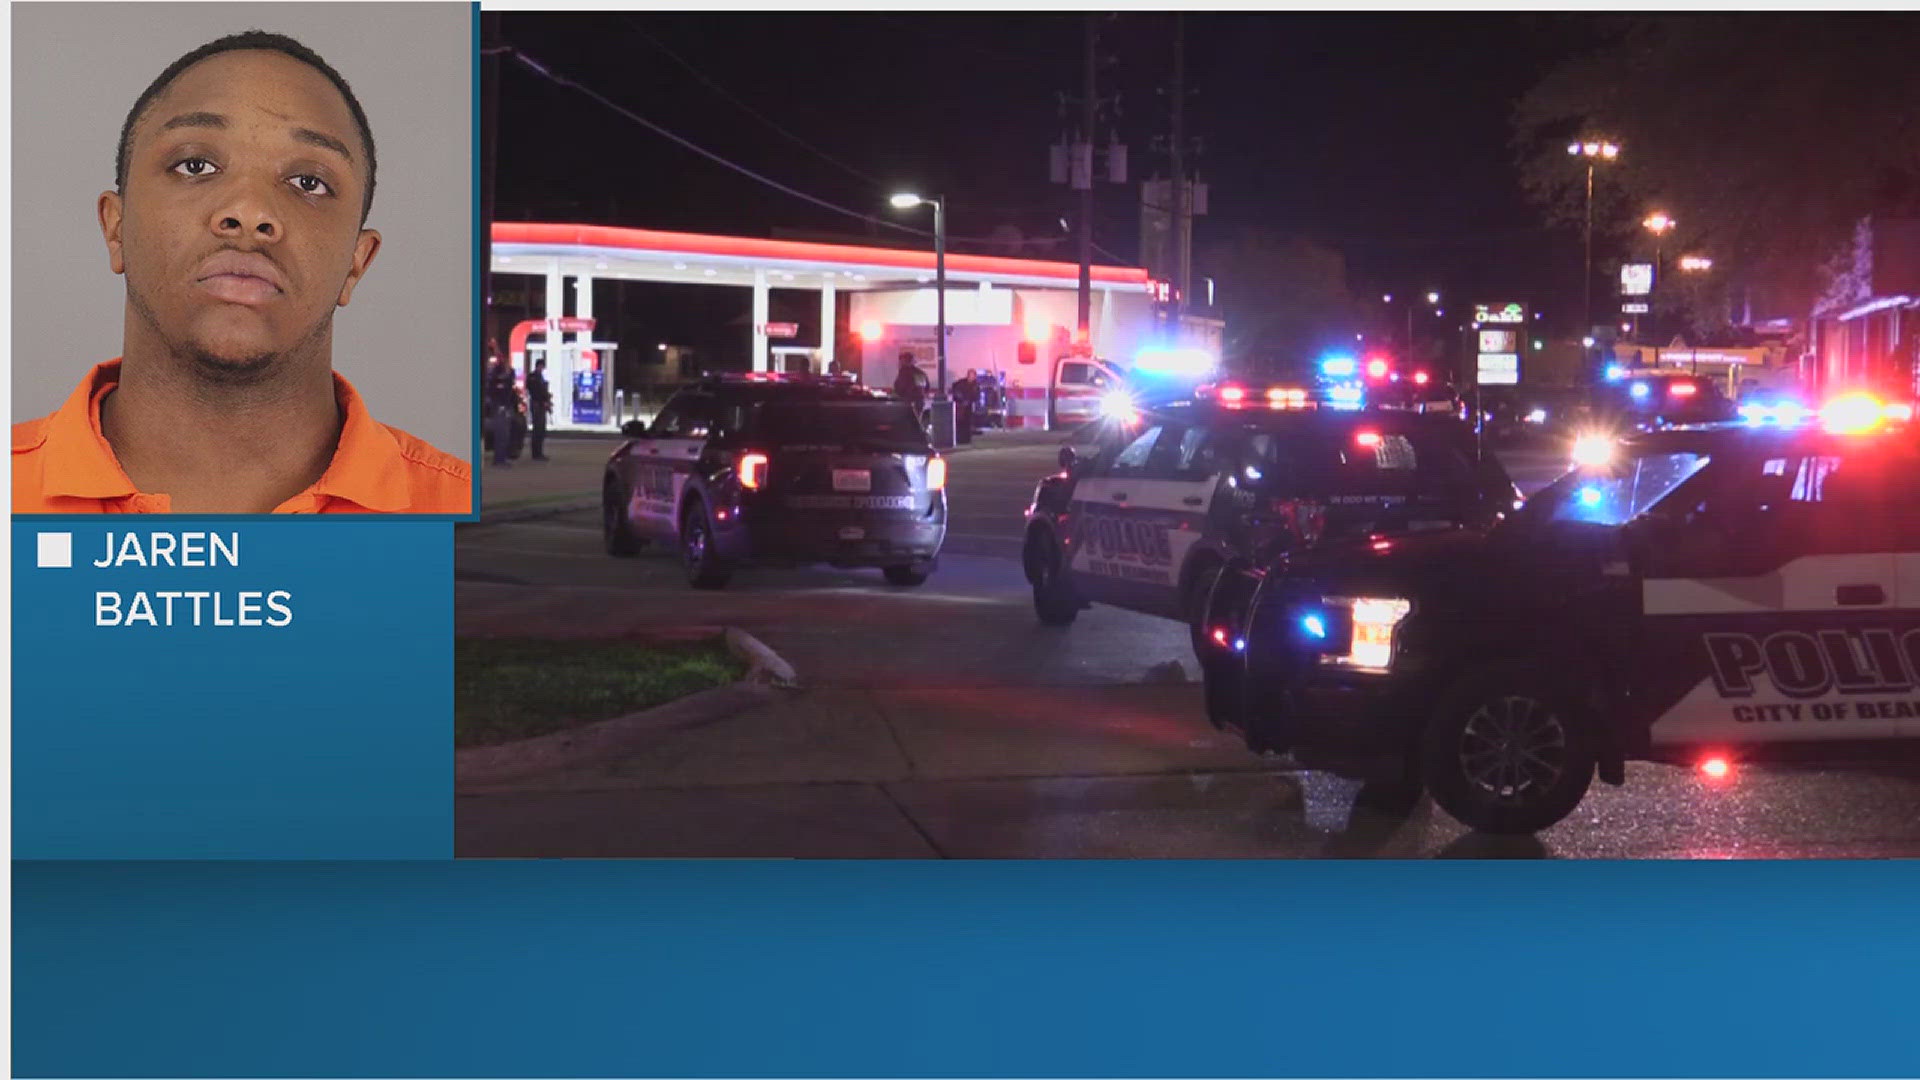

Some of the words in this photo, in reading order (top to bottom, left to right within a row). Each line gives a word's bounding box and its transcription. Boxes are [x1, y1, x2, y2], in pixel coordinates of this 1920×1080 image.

[1082, 514, 1171, 566] POLICE
[1703, 628, 1920, 699] POLI
[1732, 703, 1801, 723] CITY
[1811, 702, 1848, 720] OF
